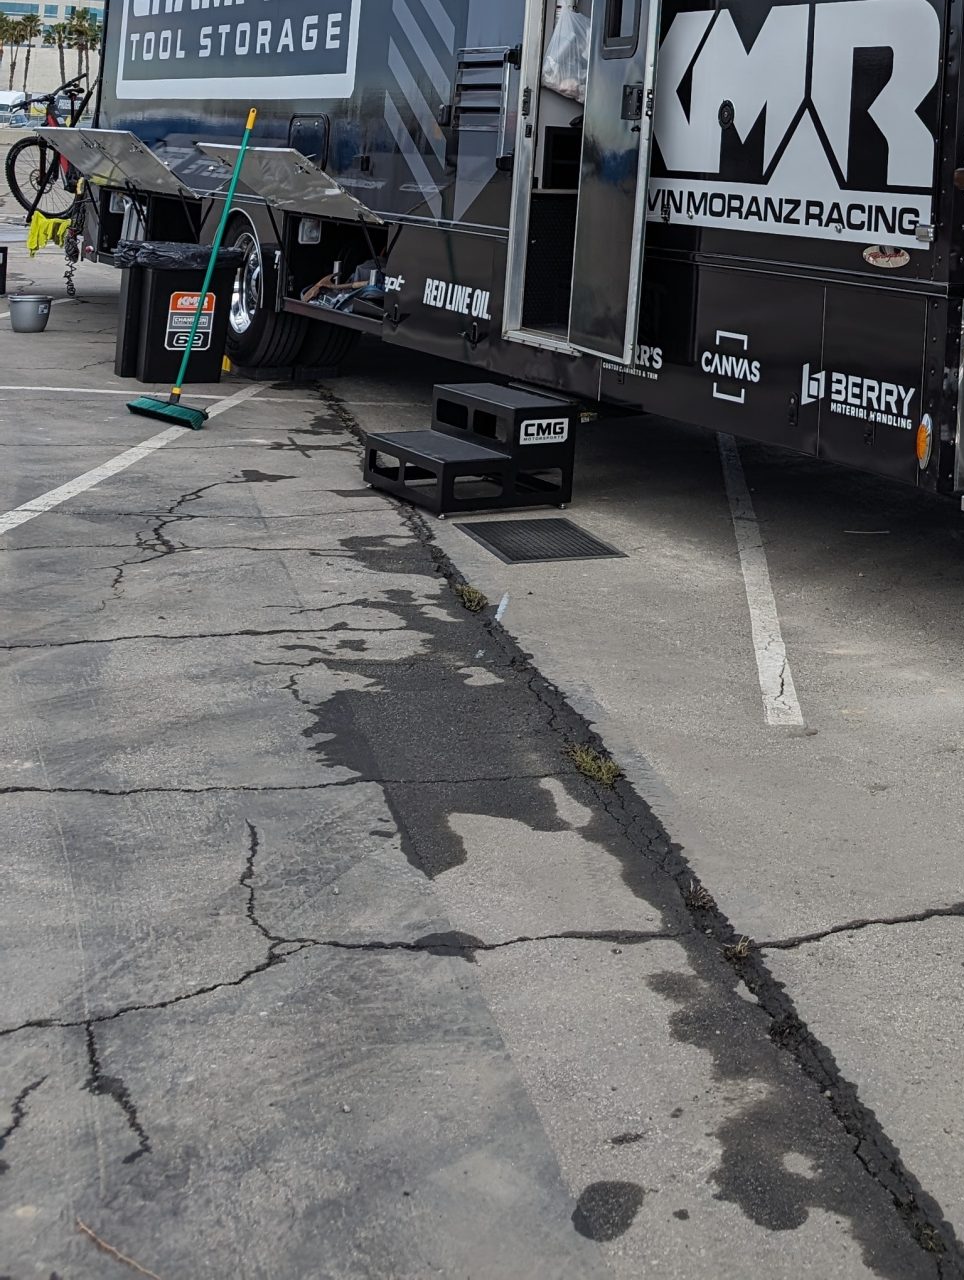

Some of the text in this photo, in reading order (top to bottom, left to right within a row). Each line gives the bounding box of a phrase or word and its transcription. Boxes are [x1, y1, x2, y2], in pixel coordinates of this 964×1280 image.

[130, 13, 342, 61] TOOL STORAGE
[687, 191, 802, 225] MORANZ
[804, 200, 920, 236] RACING
[423, 278, 446, 308] RED
[445, 283, 472, 315] LINE
[701, 351, 761, 383] CANVAS
[831, 371, 916, 417] BERRY
[524, 422, 565, 437] CMG
[830, 401, 913, 430] MATERIAL HANDLING
